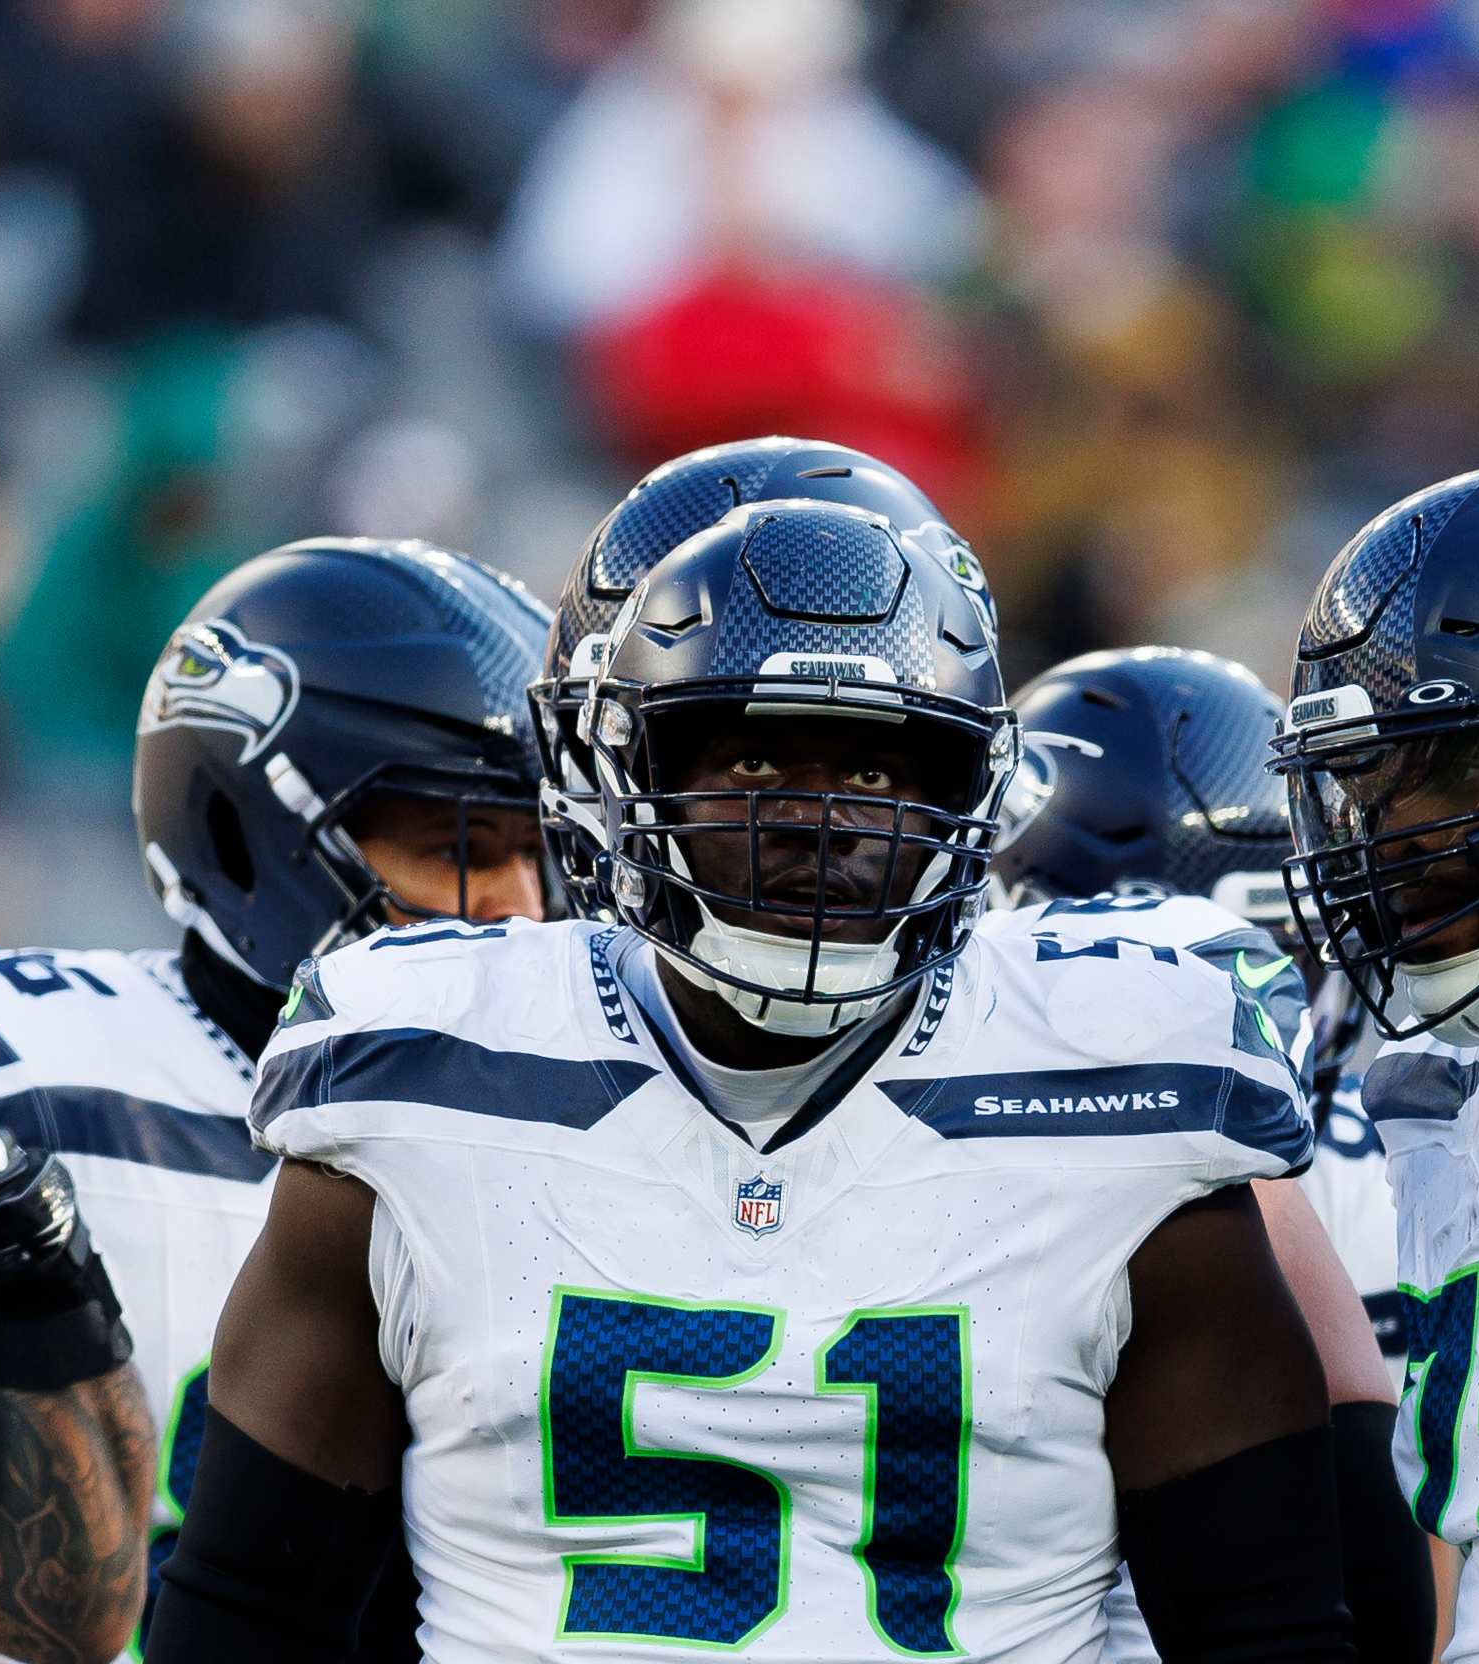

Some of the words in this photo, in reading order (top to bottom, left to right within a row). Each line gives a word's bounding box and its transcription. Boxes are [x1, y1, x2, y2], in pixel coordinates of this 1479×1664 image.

[790, 660, 866, 679] SEAHAWKS
[974, 1090, 1180, 1116] SEAHAWKS
[740, 1200, 775, 1227] NFL
[539, 1284, 973, 1658] 51
